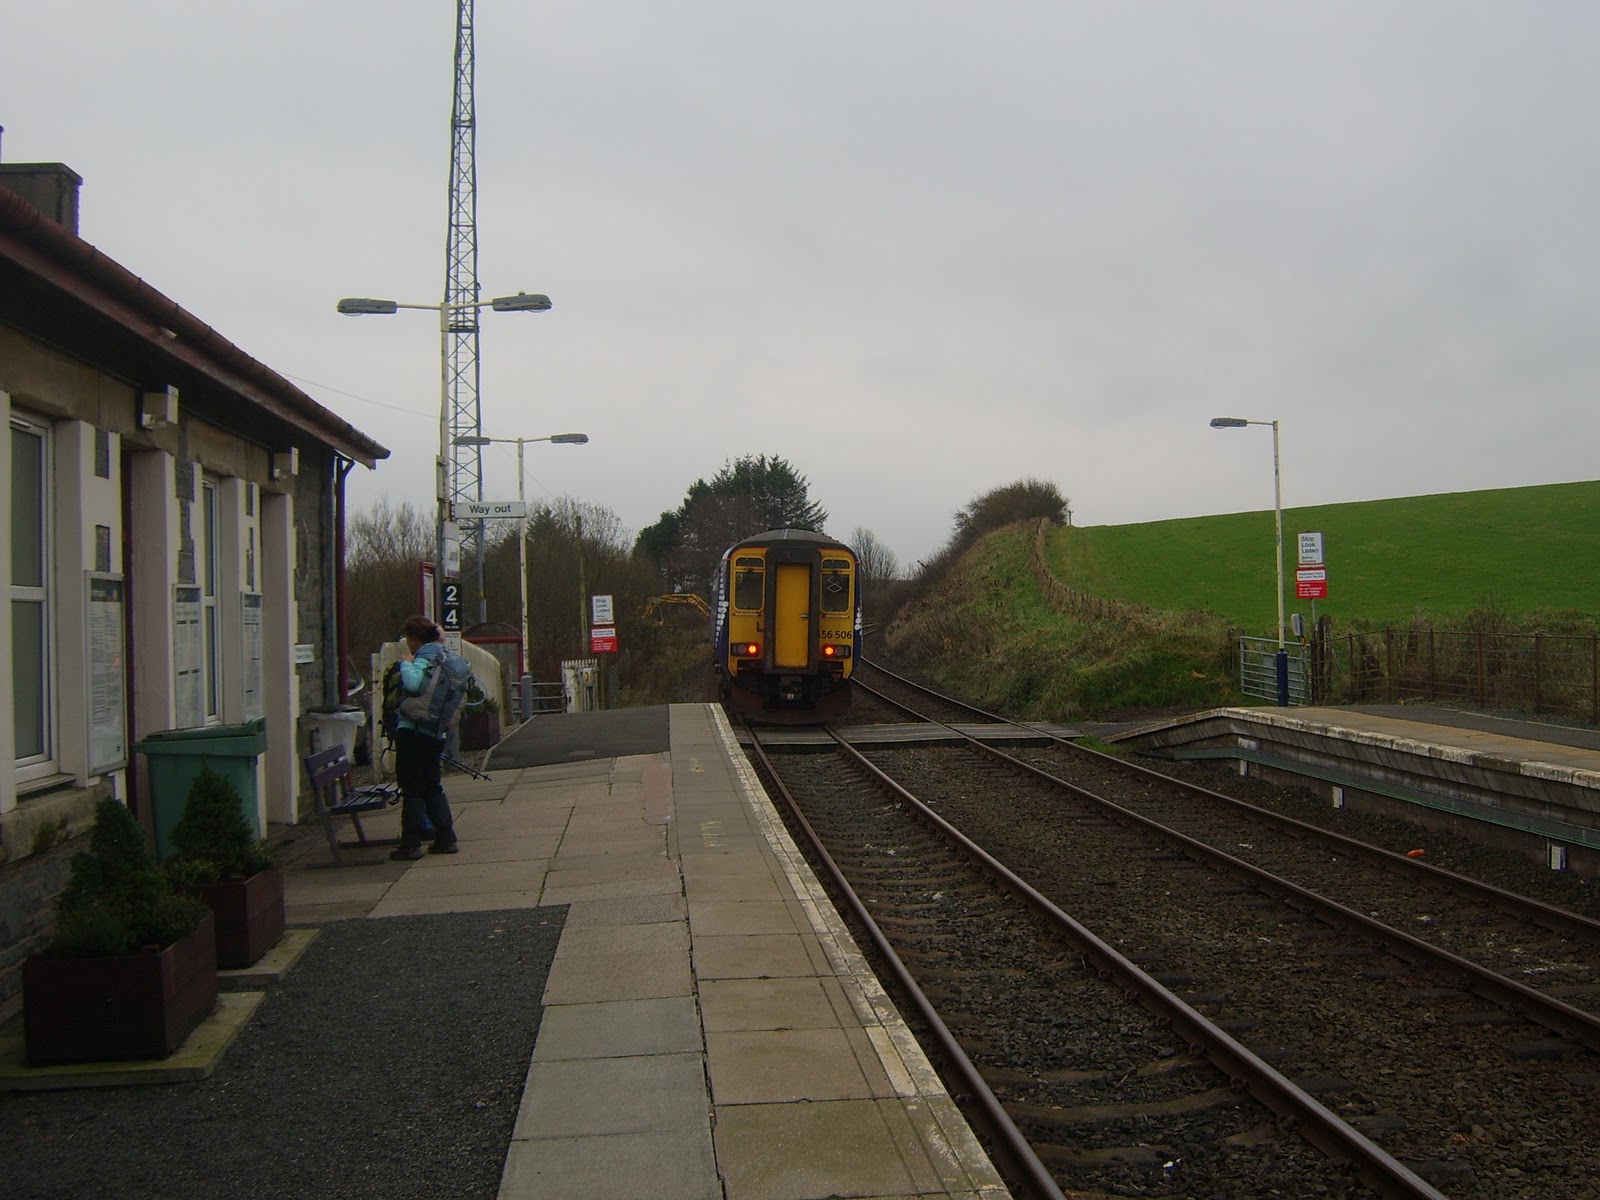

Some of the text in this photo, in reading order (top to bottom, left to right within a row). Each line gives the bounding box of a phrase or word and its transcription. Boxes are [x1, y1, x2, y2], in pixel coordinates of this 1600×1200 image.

[469, 504, 511, 515] Way out
[446, 585, 457, 601] 2
[445, 609, 458, 625] 4
[835, 630, 852, 639] 506
